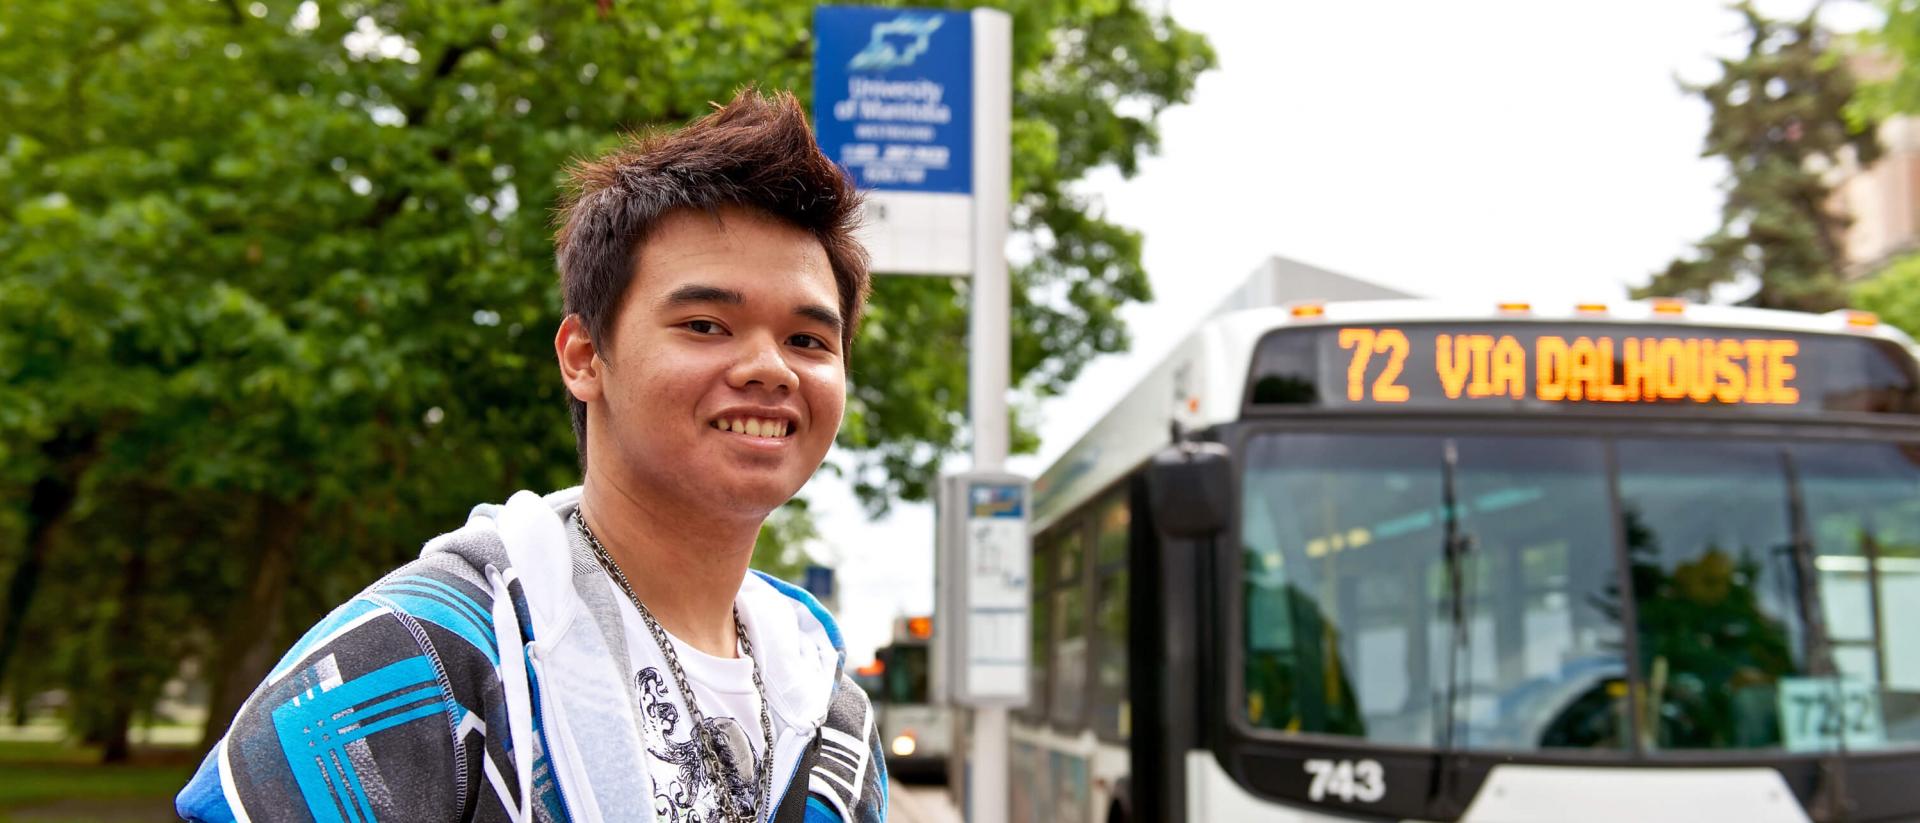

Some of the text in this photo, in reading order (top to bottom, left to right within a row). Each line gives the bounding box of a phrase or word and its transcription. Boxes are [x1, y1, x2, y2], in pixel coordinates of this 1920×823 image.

[848, 77, 944, 102] University
[833, 99, 951, 123] of Manitoba
[1338, 328, 1800, 404] 72 VIA DALHOUSIE
[1304, 759, 1386, 802] 743
